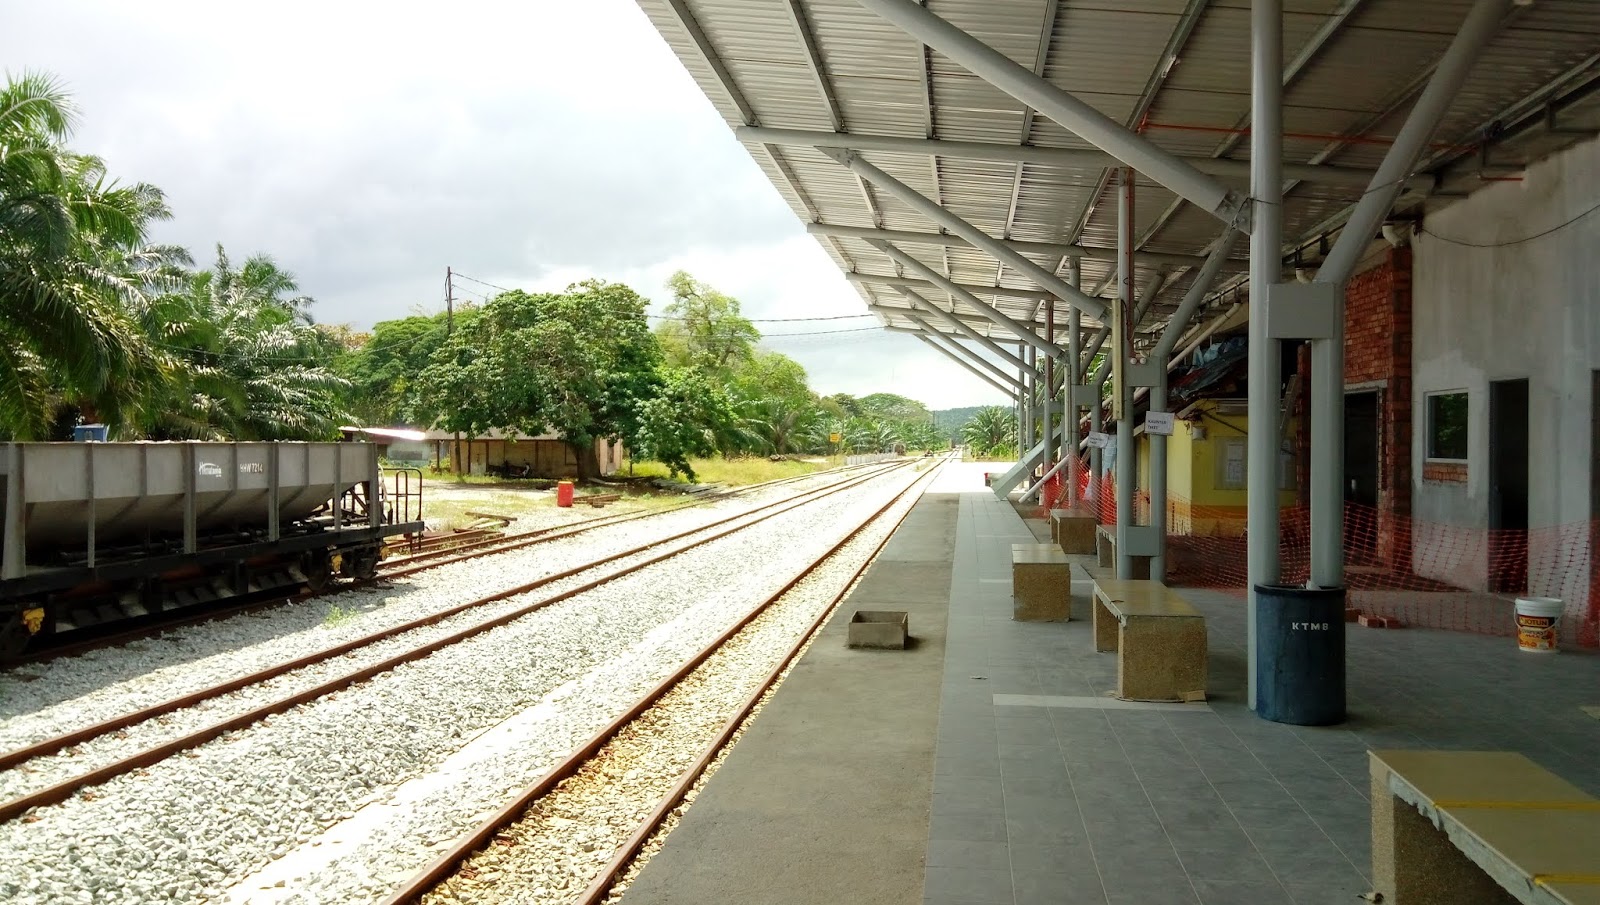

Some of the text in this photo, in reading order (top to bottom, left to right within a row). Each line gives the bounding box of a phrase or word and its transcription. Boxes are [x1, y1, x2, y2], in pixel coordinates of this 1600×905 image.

[251, 462, 263, 473] 7214
[1291, 622, 1329, 631] KTMB
[1524, 618, 1548, 626] JOTUN
